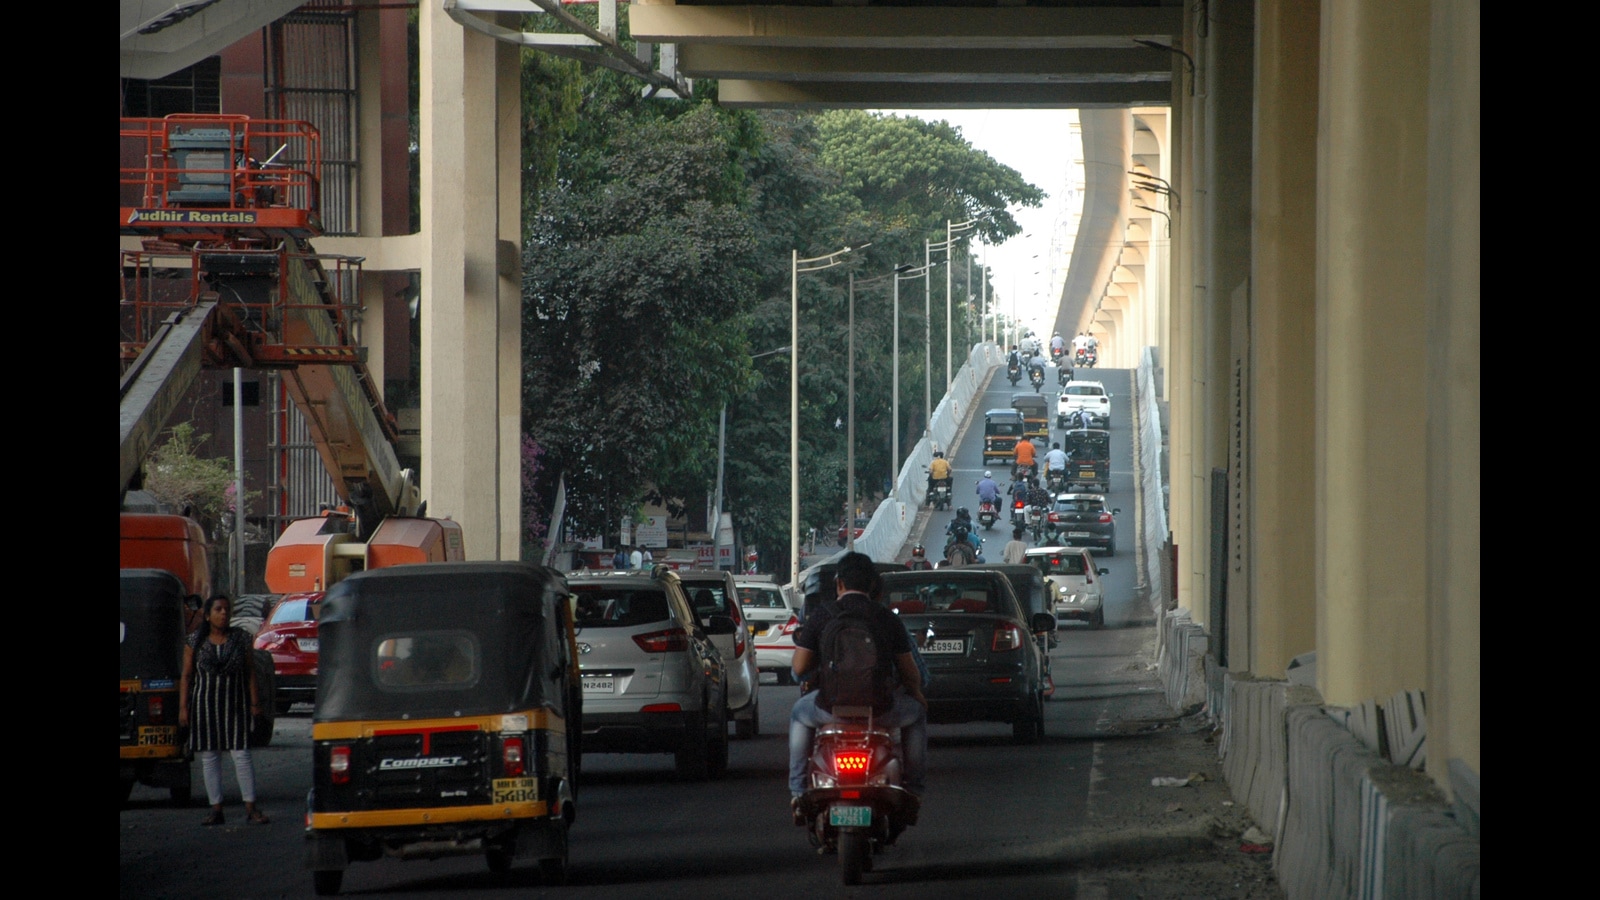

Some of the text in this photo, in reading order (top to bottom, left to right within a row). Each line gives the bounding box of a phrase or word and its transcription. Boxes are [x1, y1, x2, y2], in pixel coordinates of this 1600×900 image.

[138, 210, 254, 223] udhir Rentals
[919, 642, 962, 651] EG9943
[379, 756, 462, 768] Compact
[495, 787, 535, 803] 5484
